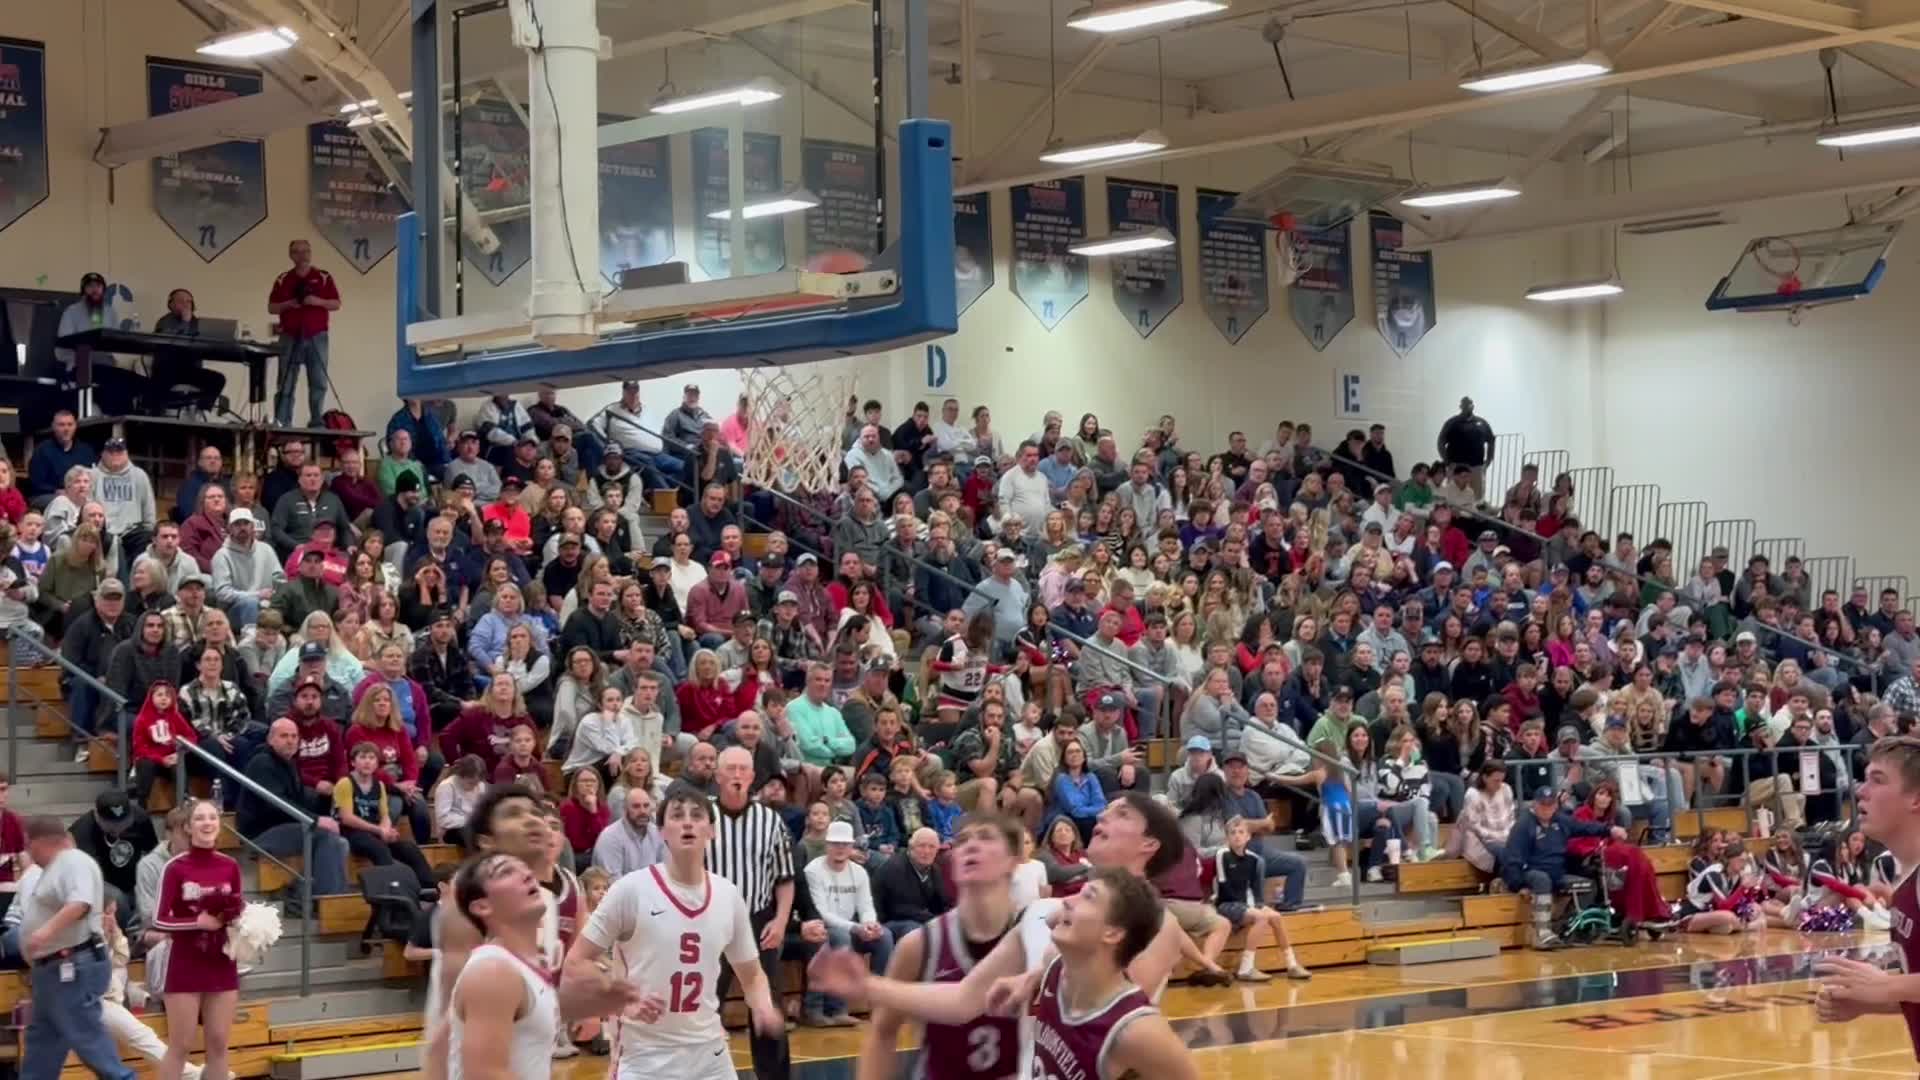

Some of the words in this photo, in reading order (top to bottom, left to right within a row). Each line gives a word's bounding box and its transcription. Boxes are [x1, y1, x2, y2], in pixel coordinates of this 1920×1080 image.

[926, 344, 948, 388] D
[1343, 374, 1361, 413] E
[679, 931, 702, 965] S
[669, 970, 705, 1013] 12
[967, 1023, 1001, 1073] 3
